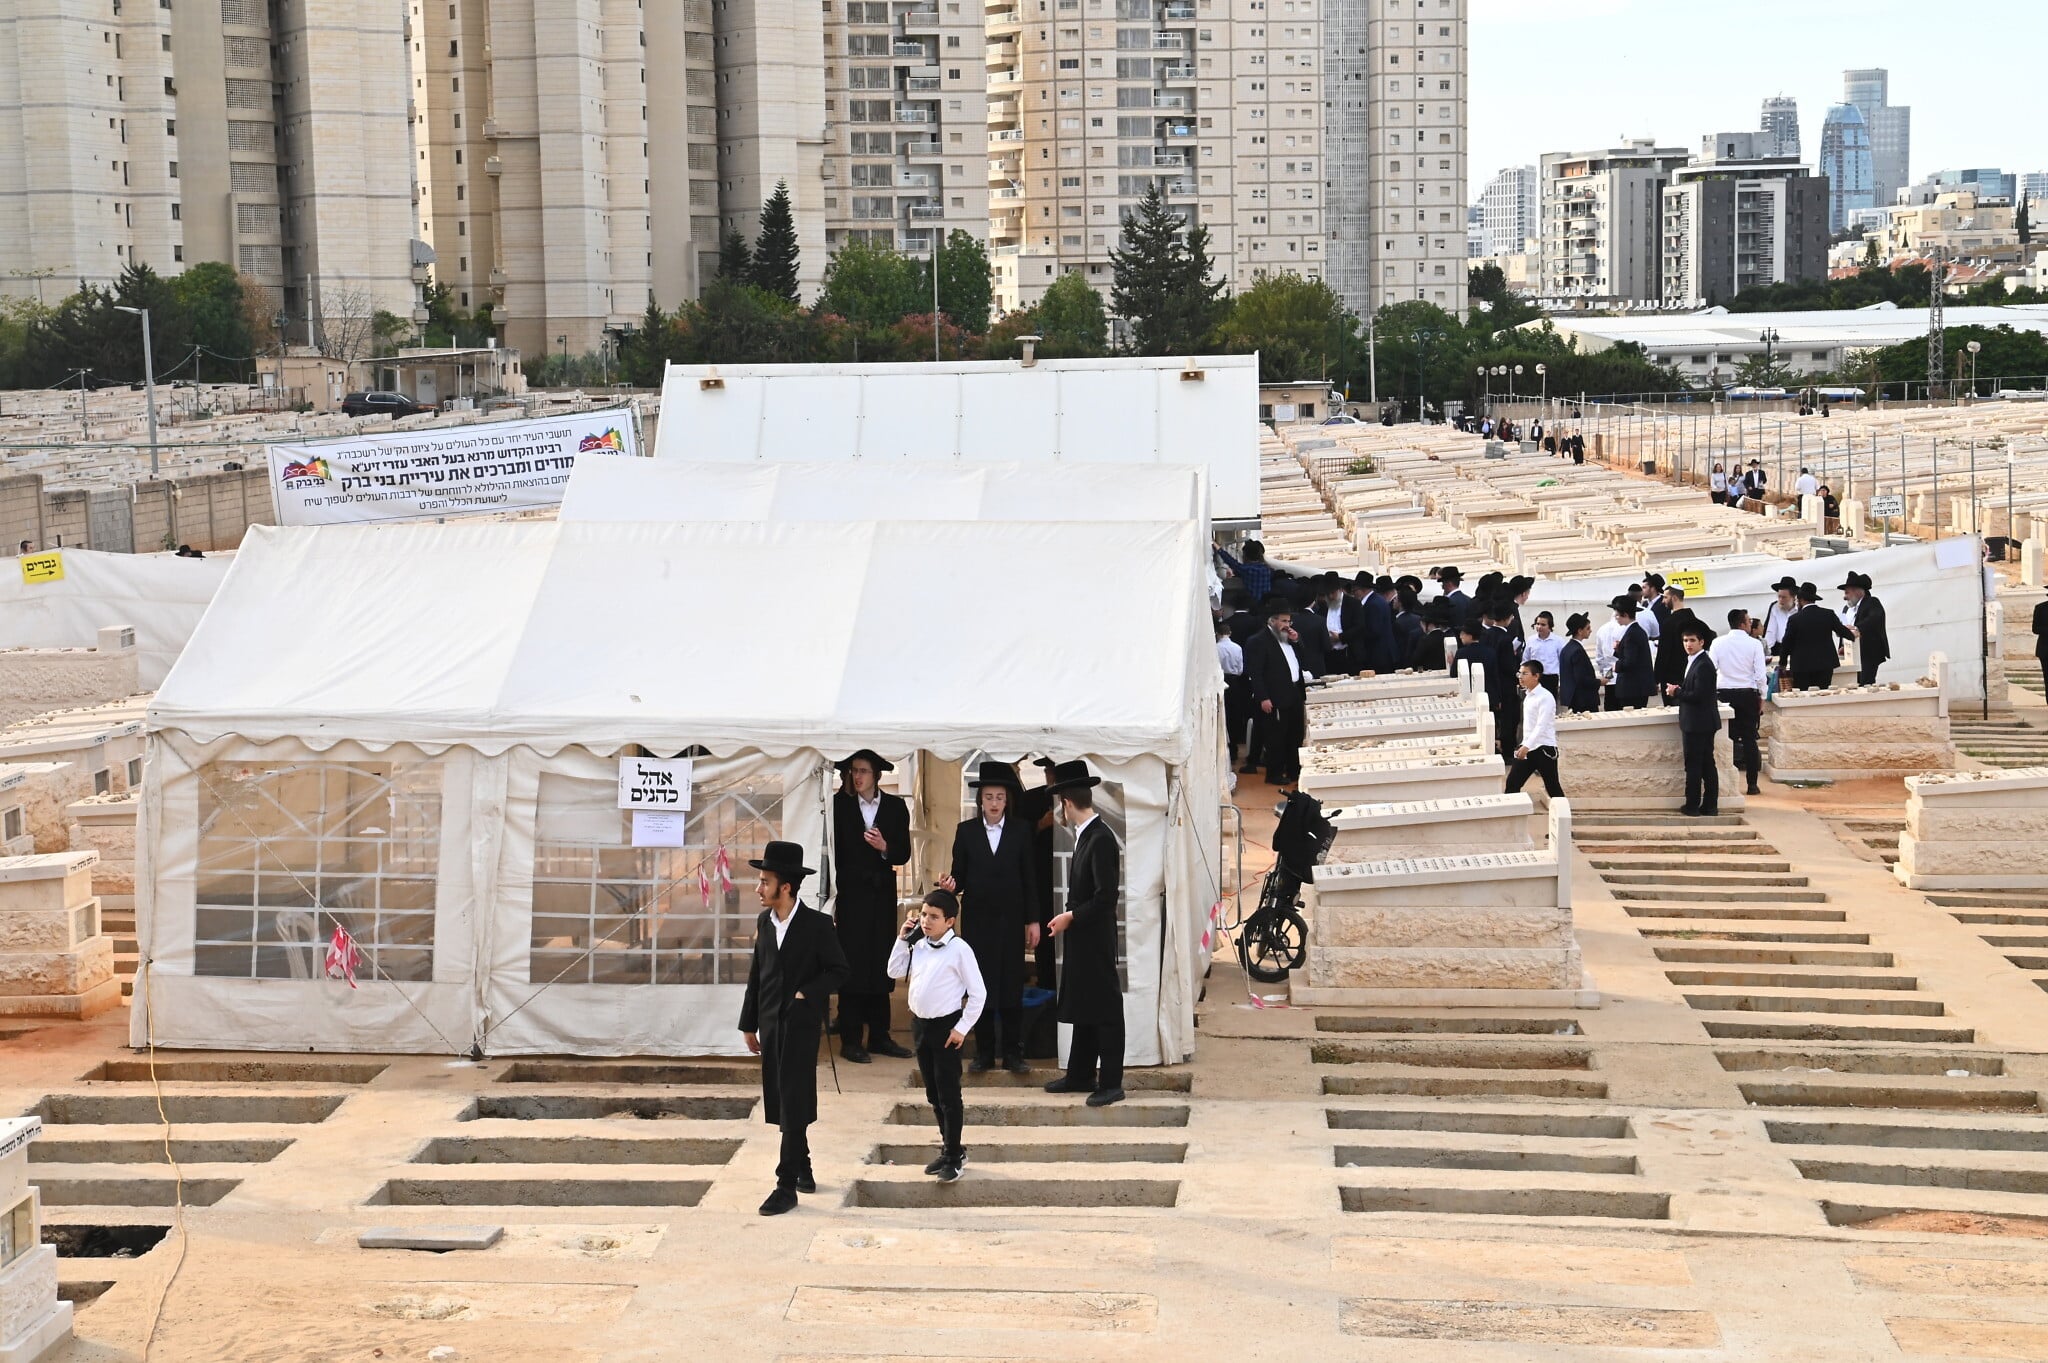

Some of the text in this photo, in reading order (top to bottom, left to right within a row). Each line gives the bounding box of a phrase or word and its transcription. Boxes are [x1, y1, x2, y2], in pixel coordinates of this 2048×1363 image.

[478, 435, 490, 446] כל
[491, 435, 505, 445] עם
[506, 434, 522, 443] יחד
[523, 431, 544, 442] העיר
[545, 429, 572, 440] תושבי
[411, 443, 430, 454] ציונו
[431, 441, 444, 452] על
[445, 437, 477, 450] העולים
[536, 443, 562, 454] רבינו
[378, 446, 393, 456] של
[467, 450, 495, 462] מרנא
[497, 446, 534, 459] הקדוש
[382, 459, 408, 471] עזרי
[411, 455, 440, 467] האבי
[442, 453, 466, 465] בעל
[341, 455, 575, 492] מודים ומברכים את עיריית בני ברק
[295, 477, 325, 489] בני ברק
[474, 478, 511, 492] ההילולא
[512, 476, 550, 489] בהוצאות
[355, 490, 389, 502] העולים
[389, 489, 417, 501] רבבות
[418, 487, 433, 498] של
[304, 496, 323, 507] שיח
[324, 494, 354, 505] לשפוך
[419, 493, 508, 510] לישועת הכלל והפרט
[26, 559, 56, 571] גברים
[1672, 576, 1699, 585] גברים
[637, 762, 673, 786] אהל
[630, 788, 679, 804] כהנים
